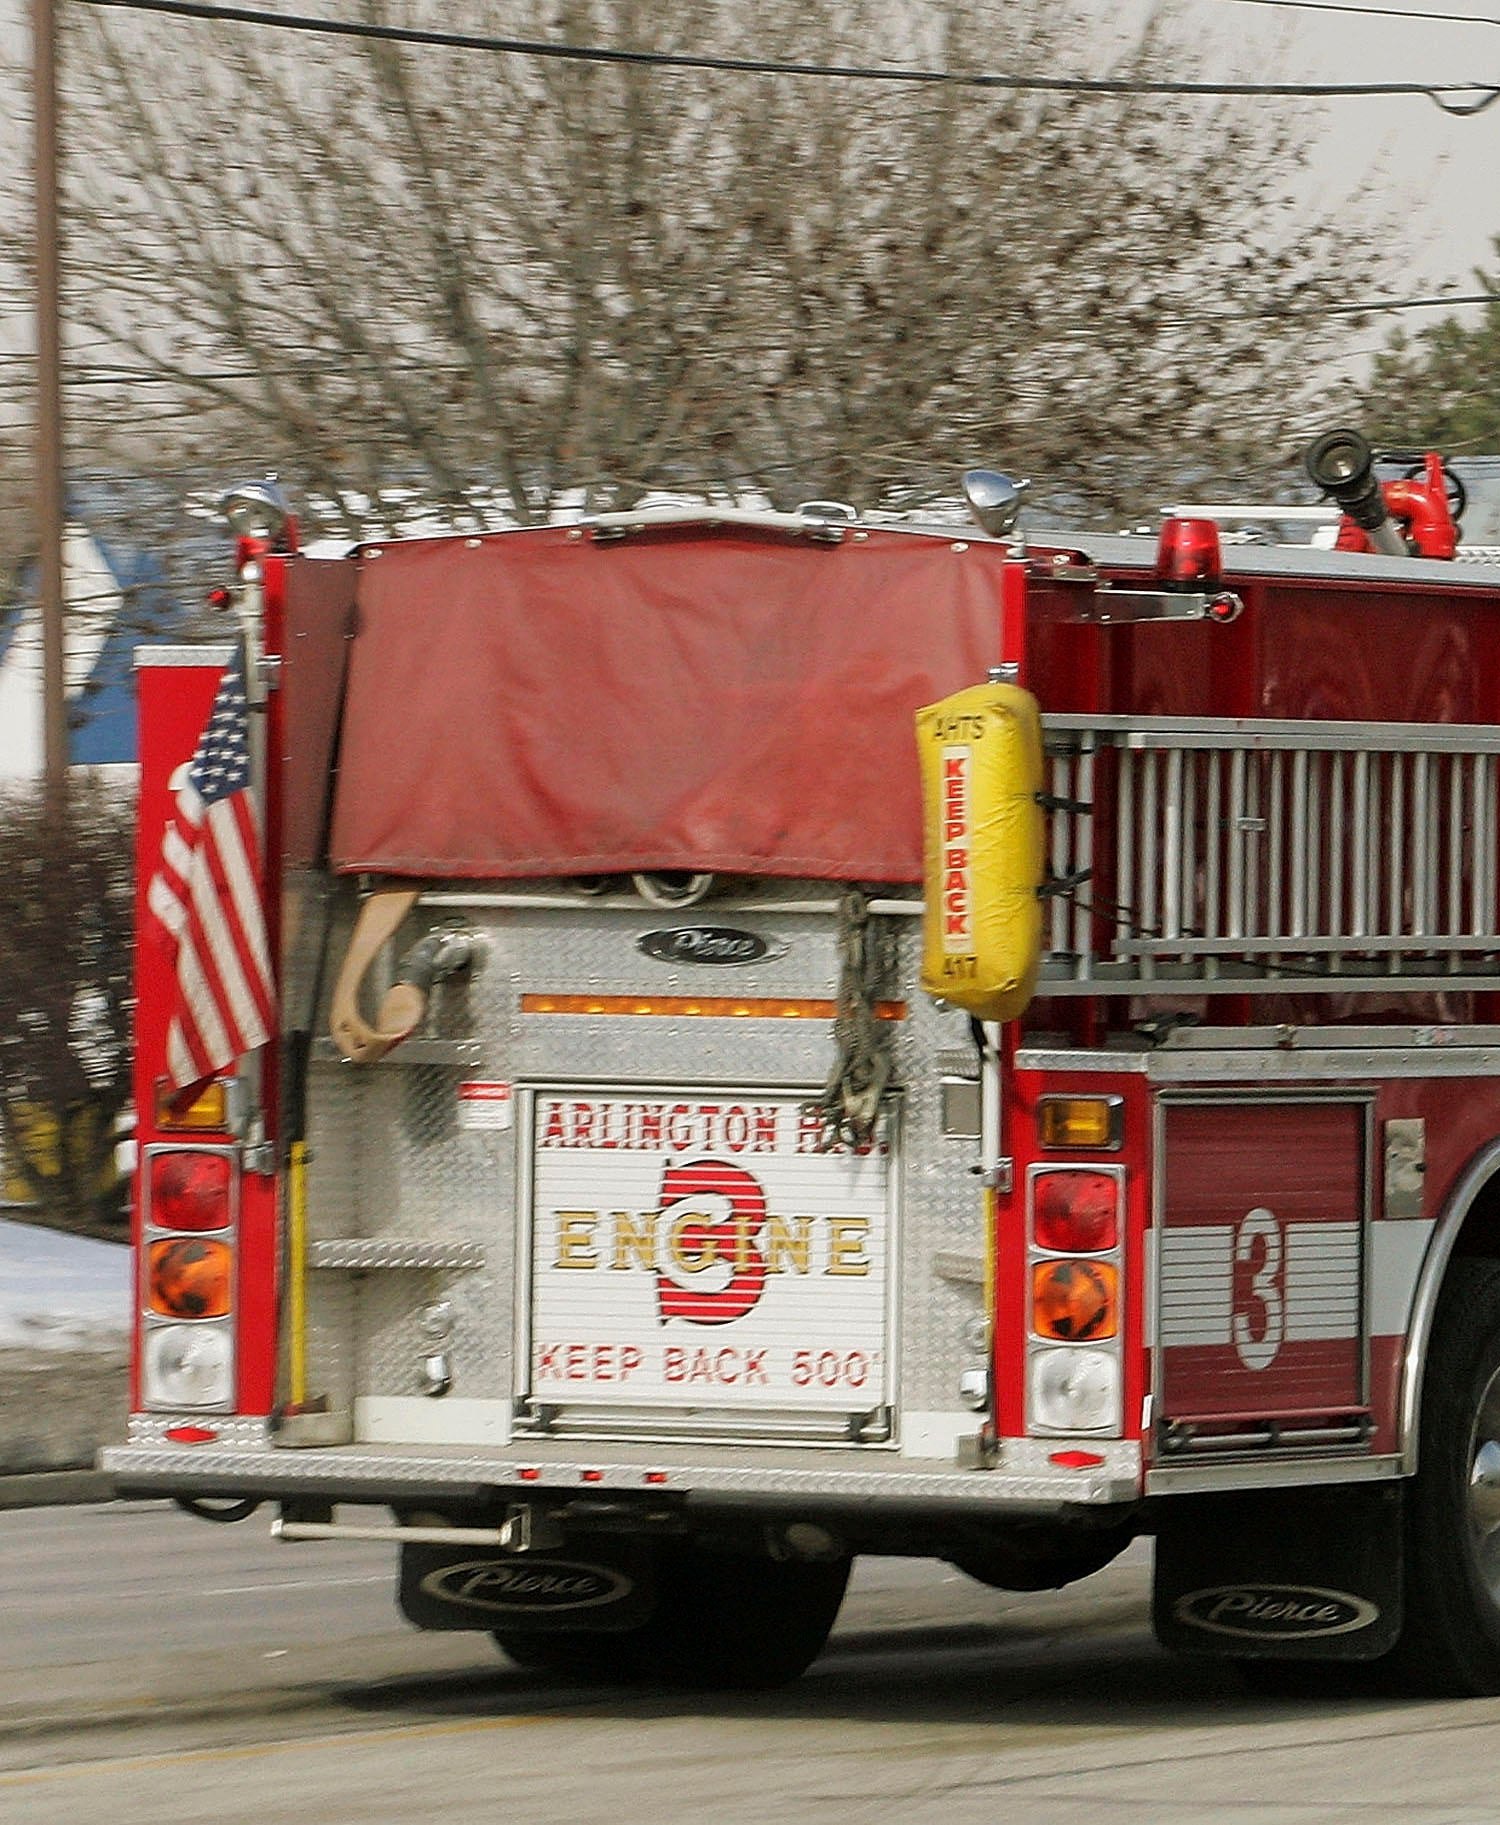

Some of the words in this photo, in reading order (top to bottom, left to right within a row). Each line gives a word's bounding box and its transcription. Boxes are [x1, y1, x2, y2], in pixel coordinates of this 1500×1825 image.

[944, 758, 966, 842] KEEP
[944, 849, 968, 935] BACK
[540, 1102, 778, 1153] ARLINGTON
[552, 1210, 871, 1276] ENGINE
[1234, 1207, 1284, 1370] 3
[537, 1343, 645, 1382] KEEP
[663, 1346, 769, 1384] BACK
[460, 1566, 600, 1596] Pierce
[1208, 1592, 1340, 1622] Pierce
